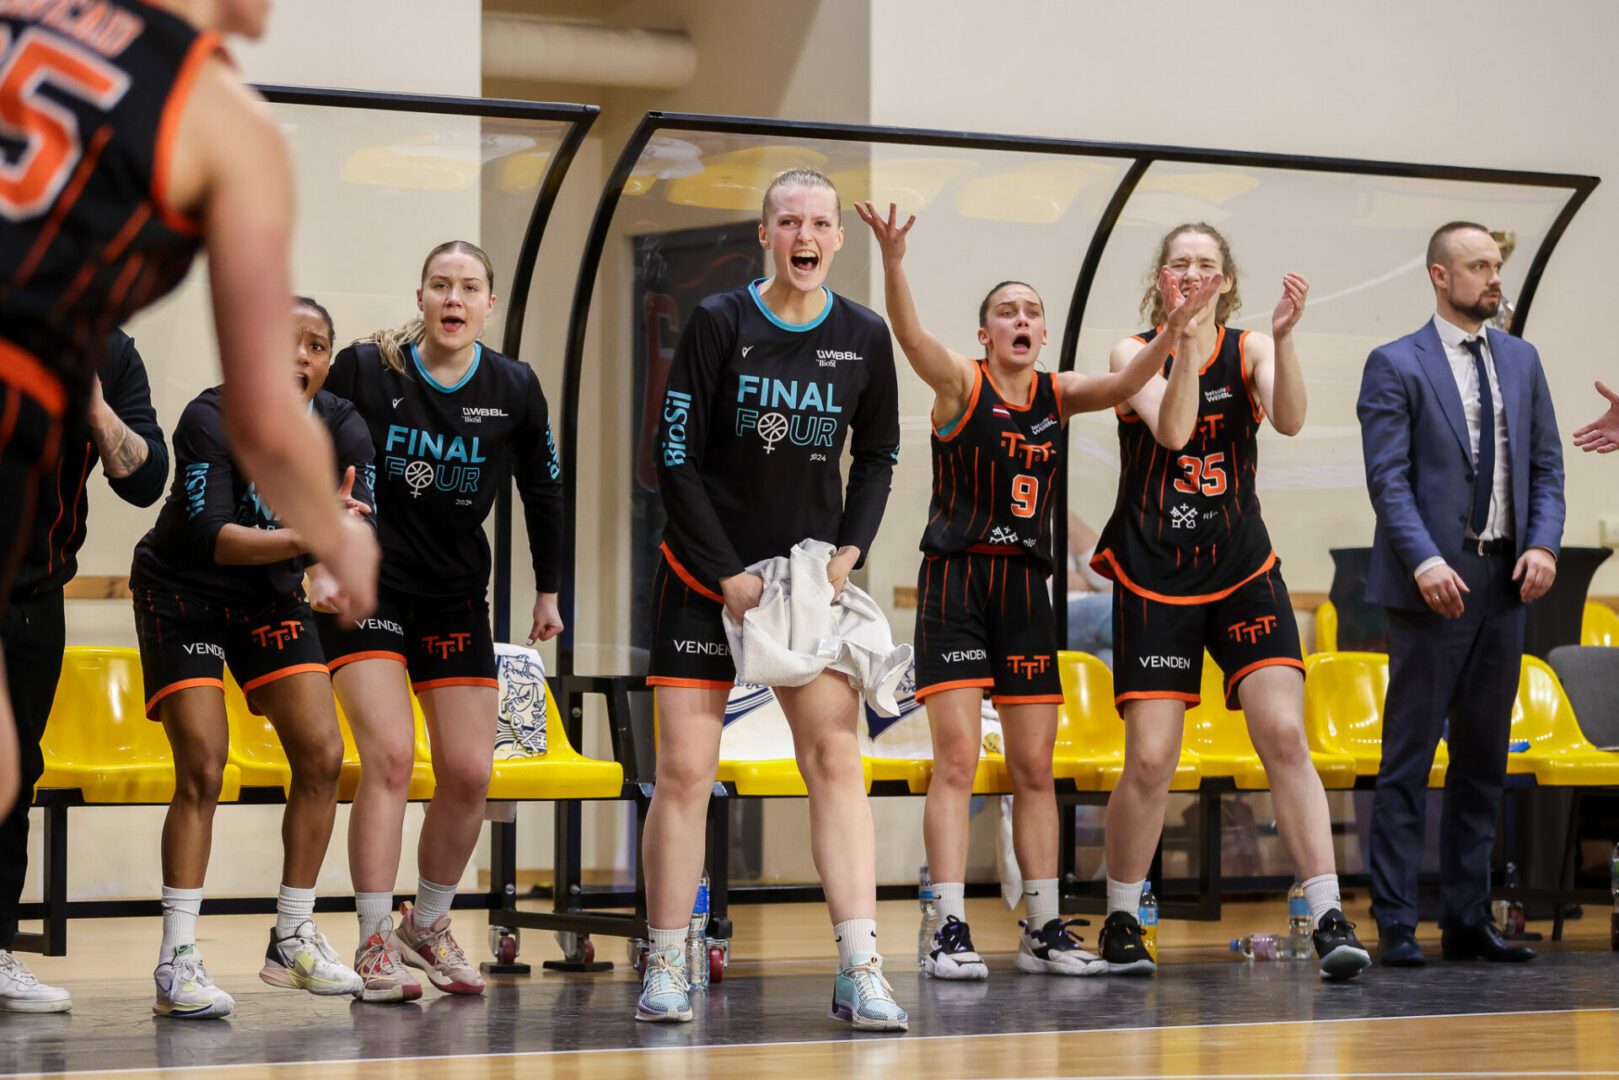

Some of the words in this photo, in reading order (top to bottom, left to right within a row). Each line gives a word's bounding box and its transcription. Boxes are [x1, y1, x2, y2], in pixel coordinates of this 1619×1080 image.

[0, 20, 132, 222] 5
[737, 374, 842, 413] FINAL
[664, 390, 692, 467] BioSil
[385, 424, 487, 463] FINAL
[1173, 452, 1227, 497] 35
[1010, 474, 1039, 518] 9
[252, 621, 303, 649] TTT
[1228, 615, 1276, 644] TTT
[183, 643, 225, 660] VENDE
[422, 633, 471, 659] TTT
[942, 649, 986, 662] VENDEN
[1007, 655, 1050, 680] TTT
[1139, 656, 1190, 669] VENDEN
